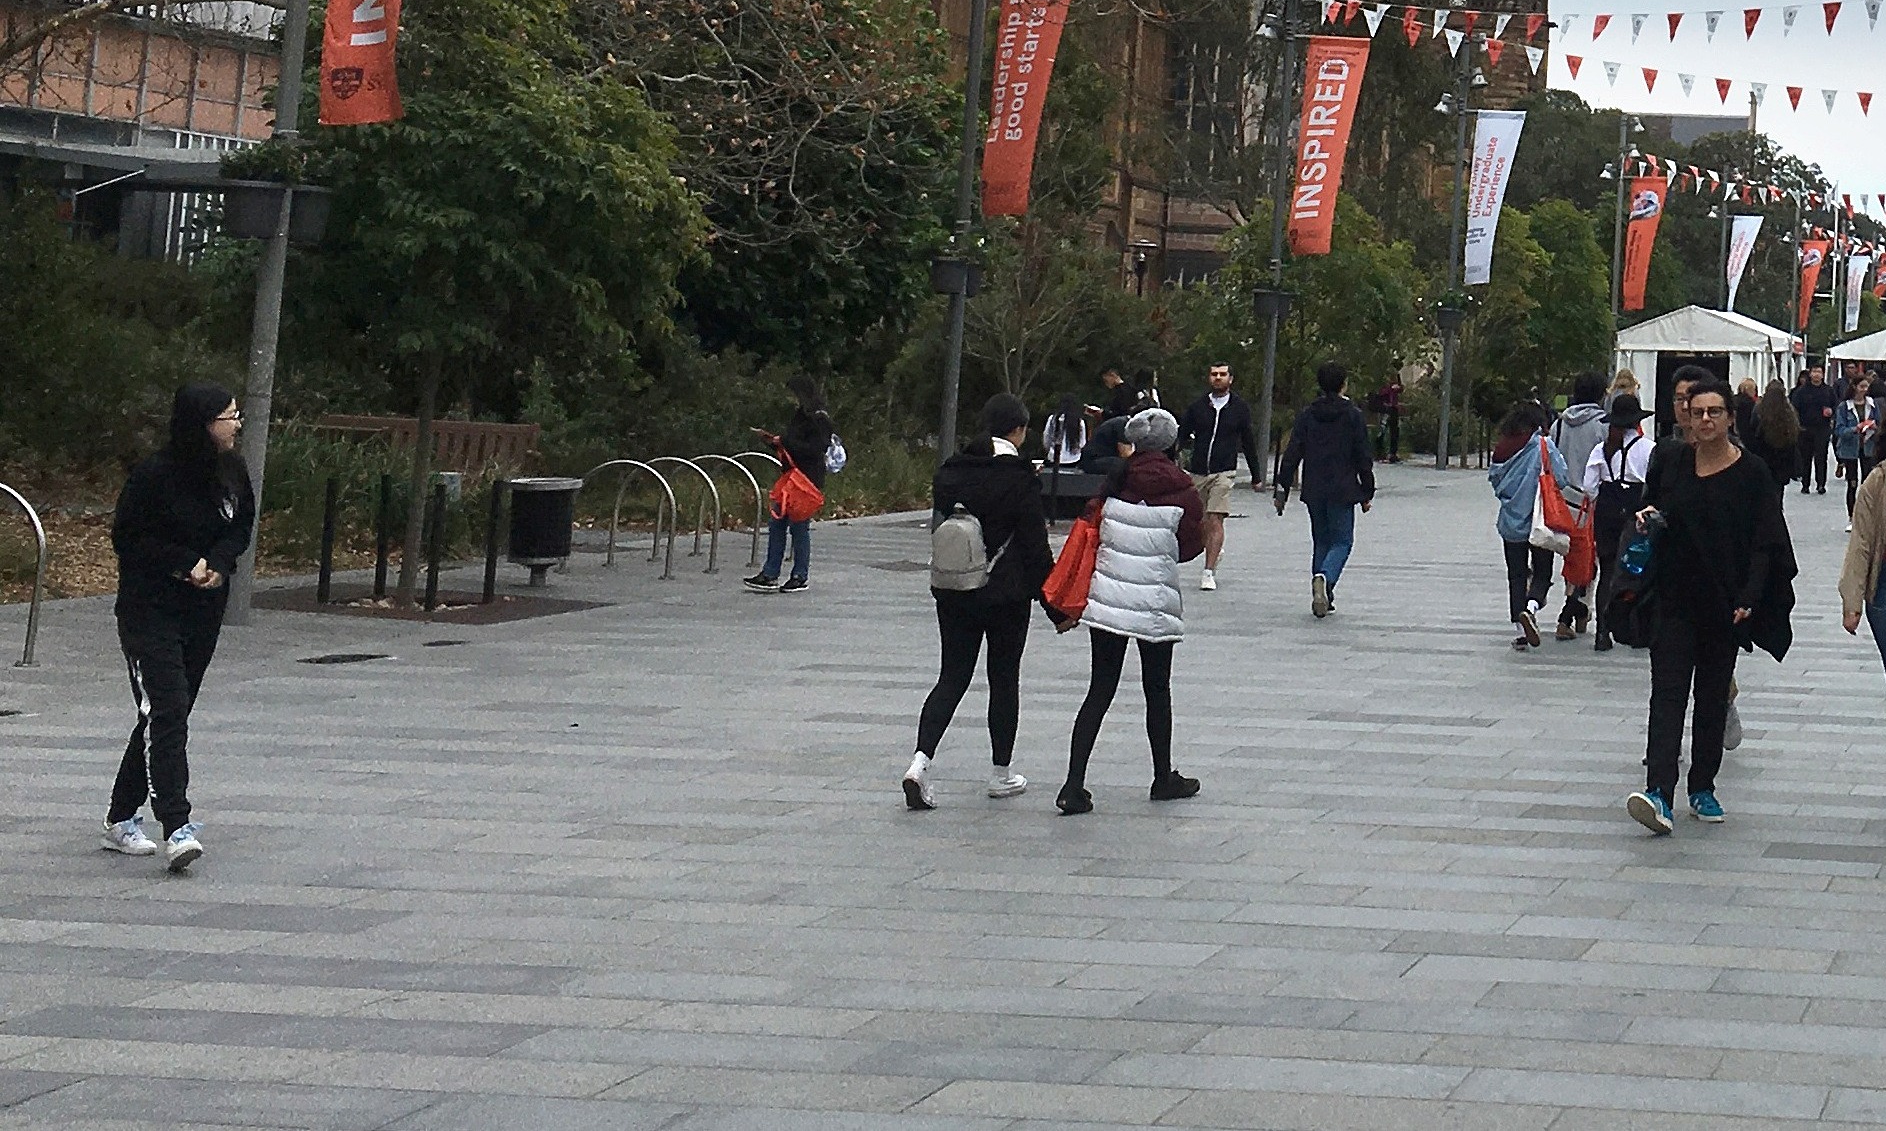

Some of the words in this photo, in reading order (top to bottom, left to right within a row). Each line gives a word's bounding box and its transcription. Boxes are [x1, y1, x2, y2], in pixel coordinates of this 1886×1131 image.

[1004, 82, 1029, 142] good
[1018, 7, 1047, 74] starts
[1295, 59, 1350, 219] INSPIRED
